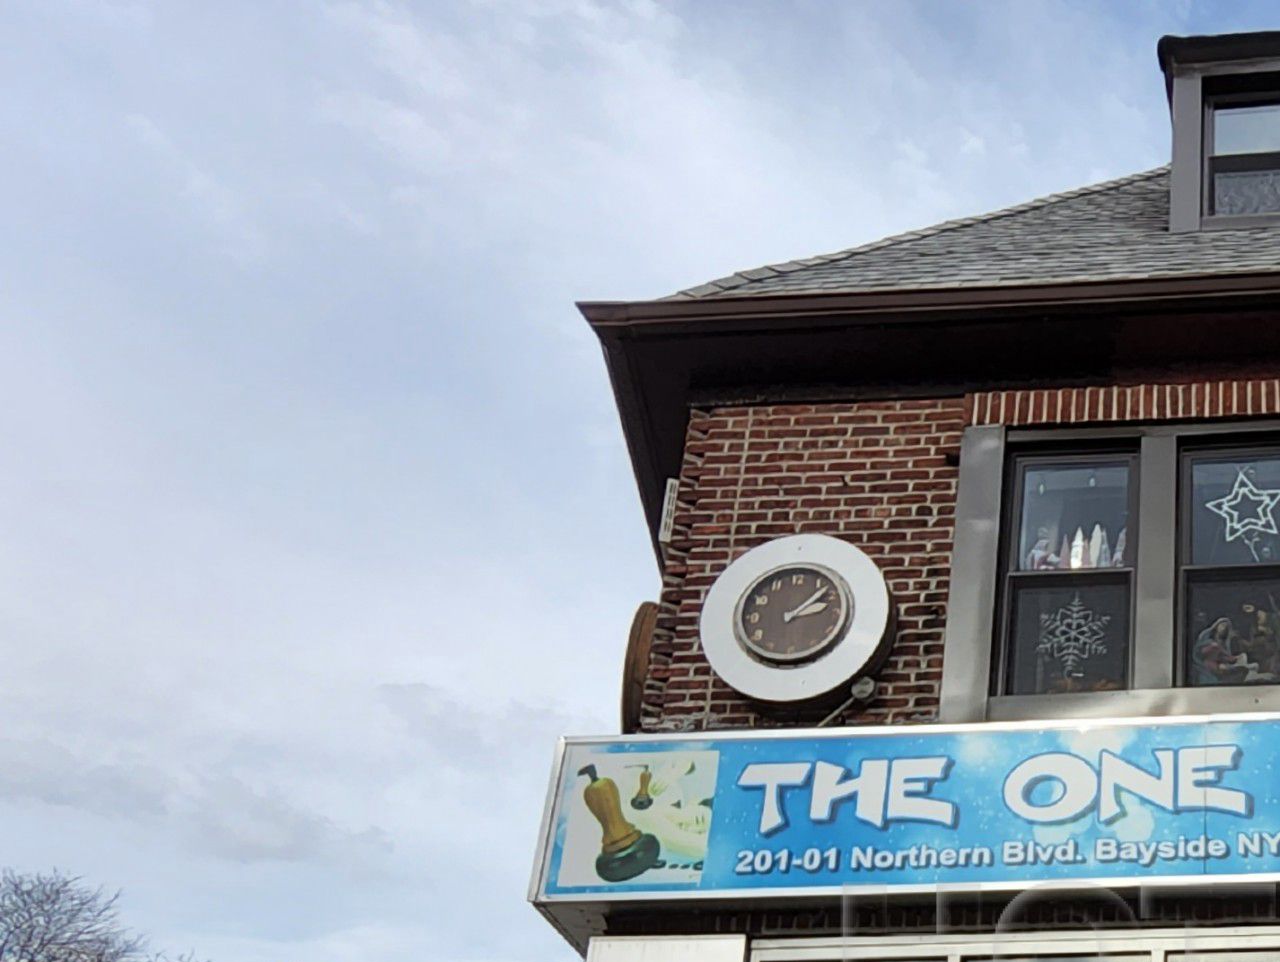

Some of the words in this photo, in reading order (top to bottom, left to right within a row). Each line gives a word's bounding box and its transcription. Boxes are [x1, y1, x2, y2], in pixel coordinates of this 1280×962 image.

[738, 756, 957, 835] THE
[1003, 745, 1252, 825] ONE
[735, 848, 840, 874] 201-01
[850, 845, 993, 870] Northern
[1002, 840, 1086, 866] Blvd.
[1094, 834, 1230, 865] Bayside
